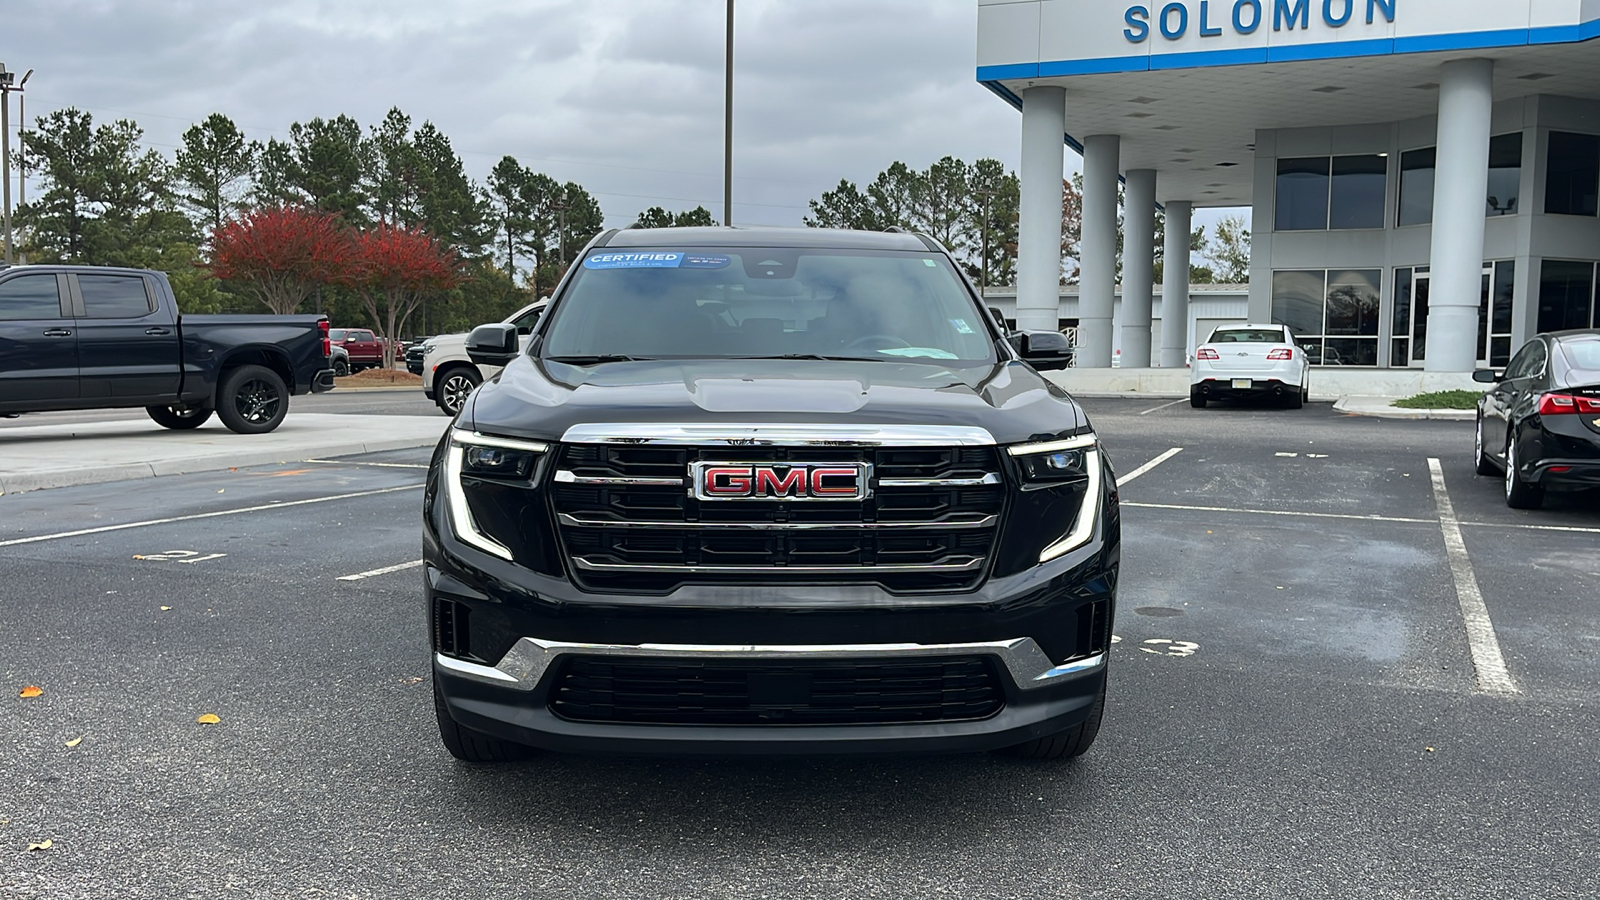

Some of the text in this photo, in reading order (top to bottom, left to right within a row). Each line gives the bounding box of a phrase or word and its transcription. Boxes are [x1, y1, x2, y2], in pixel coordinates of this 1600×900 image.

[1123, 0, 1396, 43] SOLOMON
[590, 253, 678, 263] CERTIFIED
[704, 467, 859, 497] GMC
